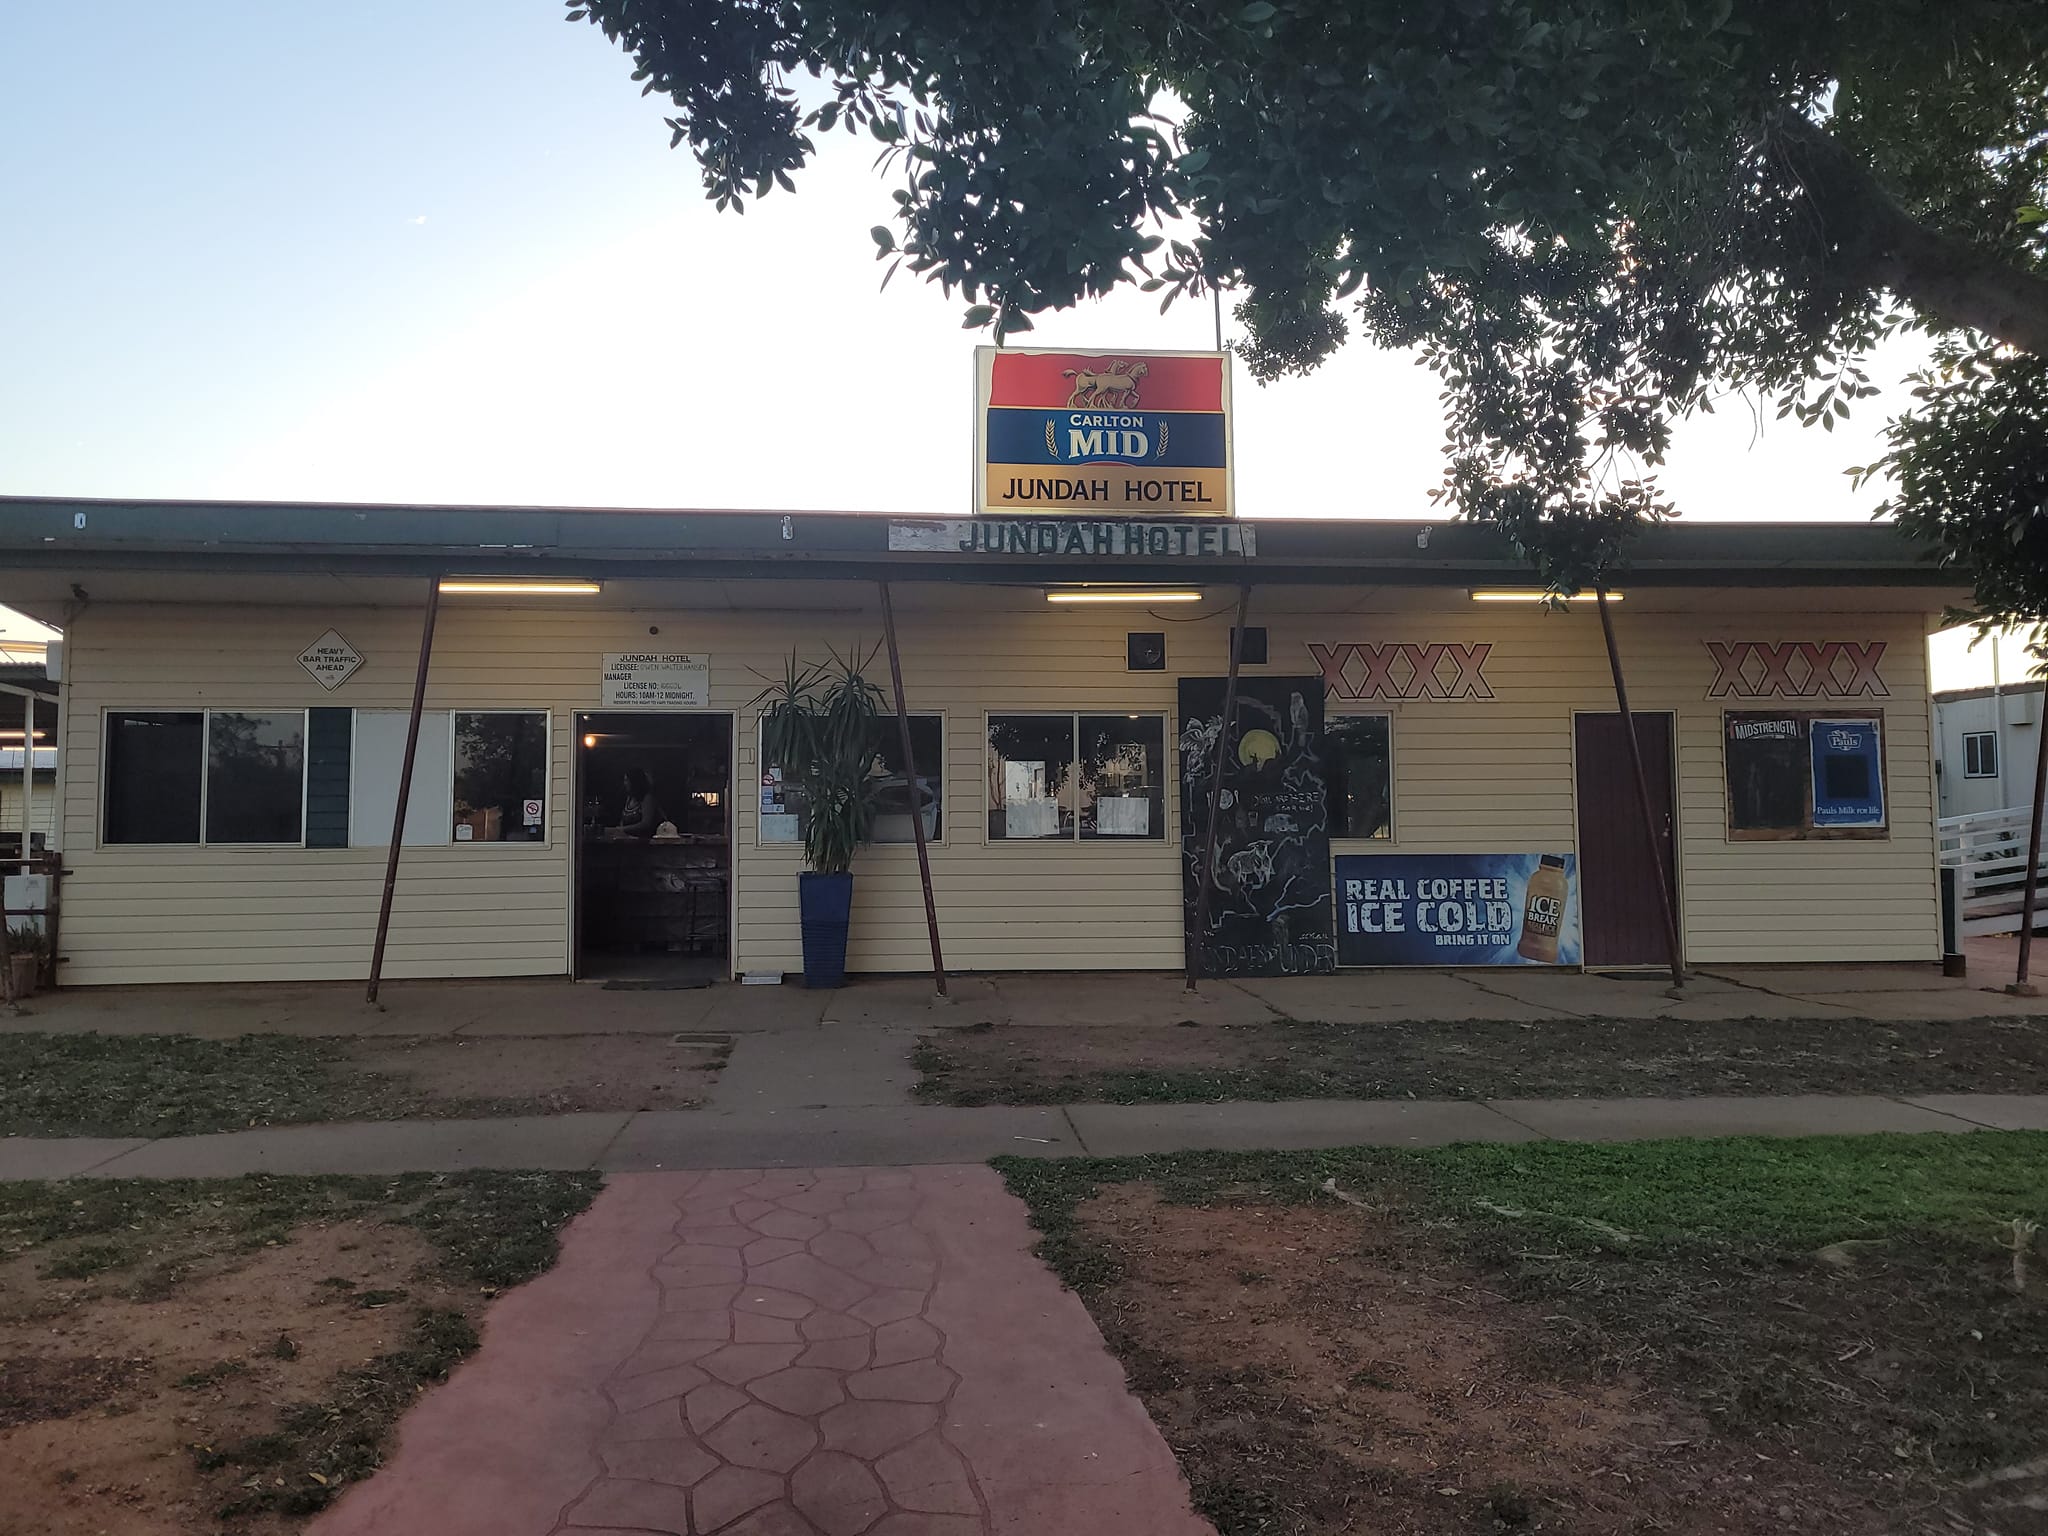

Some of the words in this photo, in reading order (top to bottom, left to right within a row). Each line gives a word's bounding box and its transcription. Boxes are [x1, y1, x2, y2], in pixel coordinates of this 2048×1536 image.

[1069, 414, 1143, 428] CARLTON
[1068, 429, 1149, 459] MID
[1002, 478, 1109, 501] JUNDAH
[1125, 480, 1212, 503] HOTEL
[958, 521, 1112, 555] JUNDAH
[1124, 523, 1241, 557] HOTEL
[317, 647, 345, 655] HEAVY
[620, 654, 658, 662] JUNDAH
[302, 655, 321, 663] BAR
[603, 672, 632, 681] MANAGER
[1307, 643, 1496, 699] XXXX
[1706, 641, 1891, 697] XXXX
[623, 682, 648, 690] LICENSE
[1734, 719, 1797, 740] MIDSTRENGTH
[1832, 736, 1858, 747] Pauls
[1817, 806, 1838, 815] Pauls
[1838, 806, 1856, 815] Milk
[1345, 879, 1411, 901] REAL
[1417, 878, 1508, 900] COFFEE
[1528, 895, 1561, 917] ICE
[1346, 902, 1406, 933] ICE
[1416, 901, 1512, 933] COLD
[1527, 911, 1557, 926] BREAK
[1435, 934, 1475, 946] BRING
[1477, 934, 1489, 946] IT
[1492, 934, 1511, 946] ON
